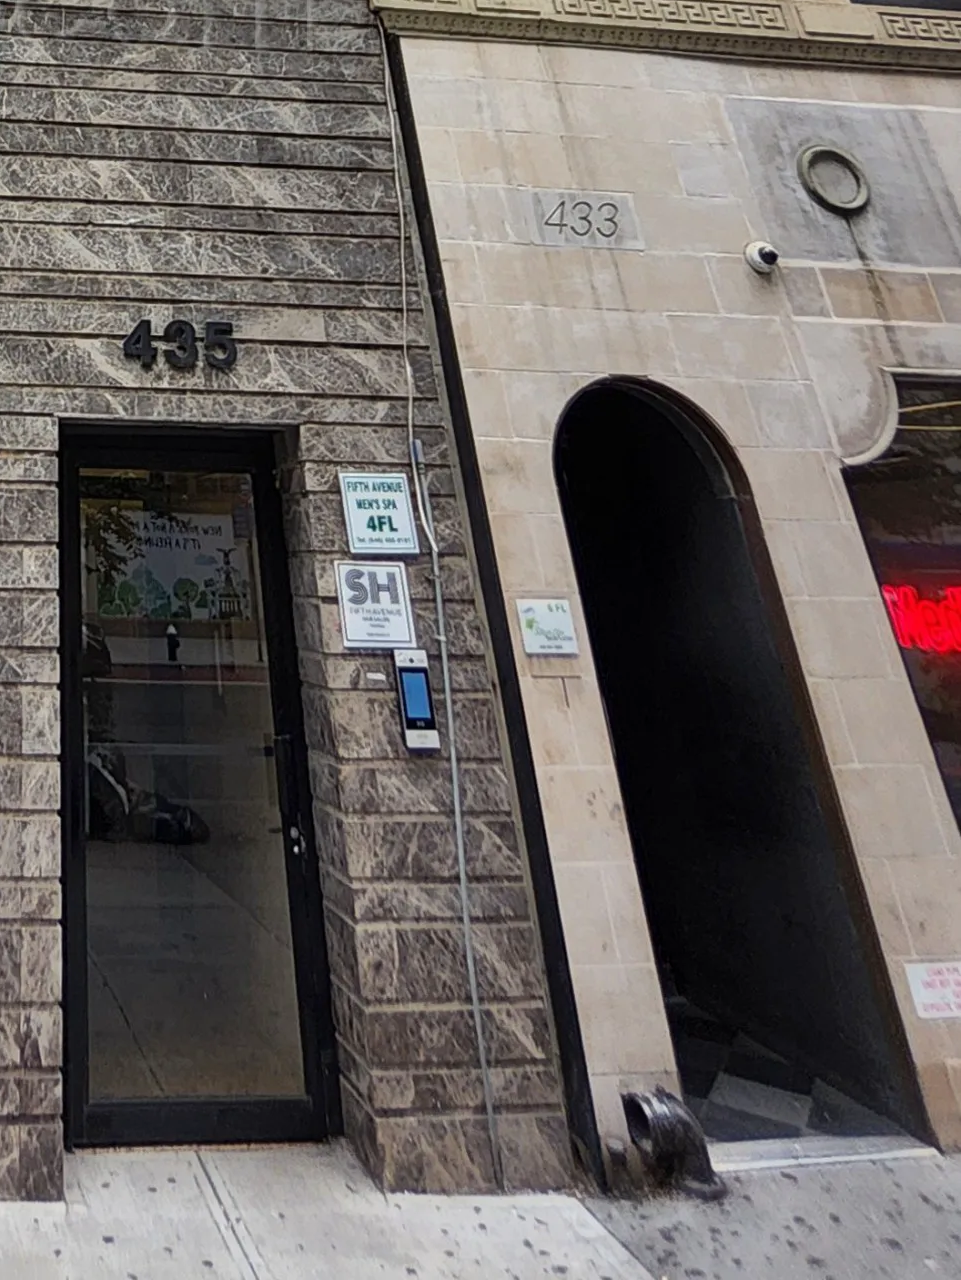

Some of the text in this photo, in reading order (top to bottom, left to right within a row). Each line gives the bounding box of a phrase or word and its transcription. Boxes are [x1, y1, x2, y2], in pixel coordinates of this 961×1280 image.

[544, 199, 620, 238] 433
[122, 319, 238, 369] 435
[346, 481, 404, 493] FIFTH AVENUE
[355, 499, 398, 510] MEN'S SPA
[345, 568, 400, 605] SH
